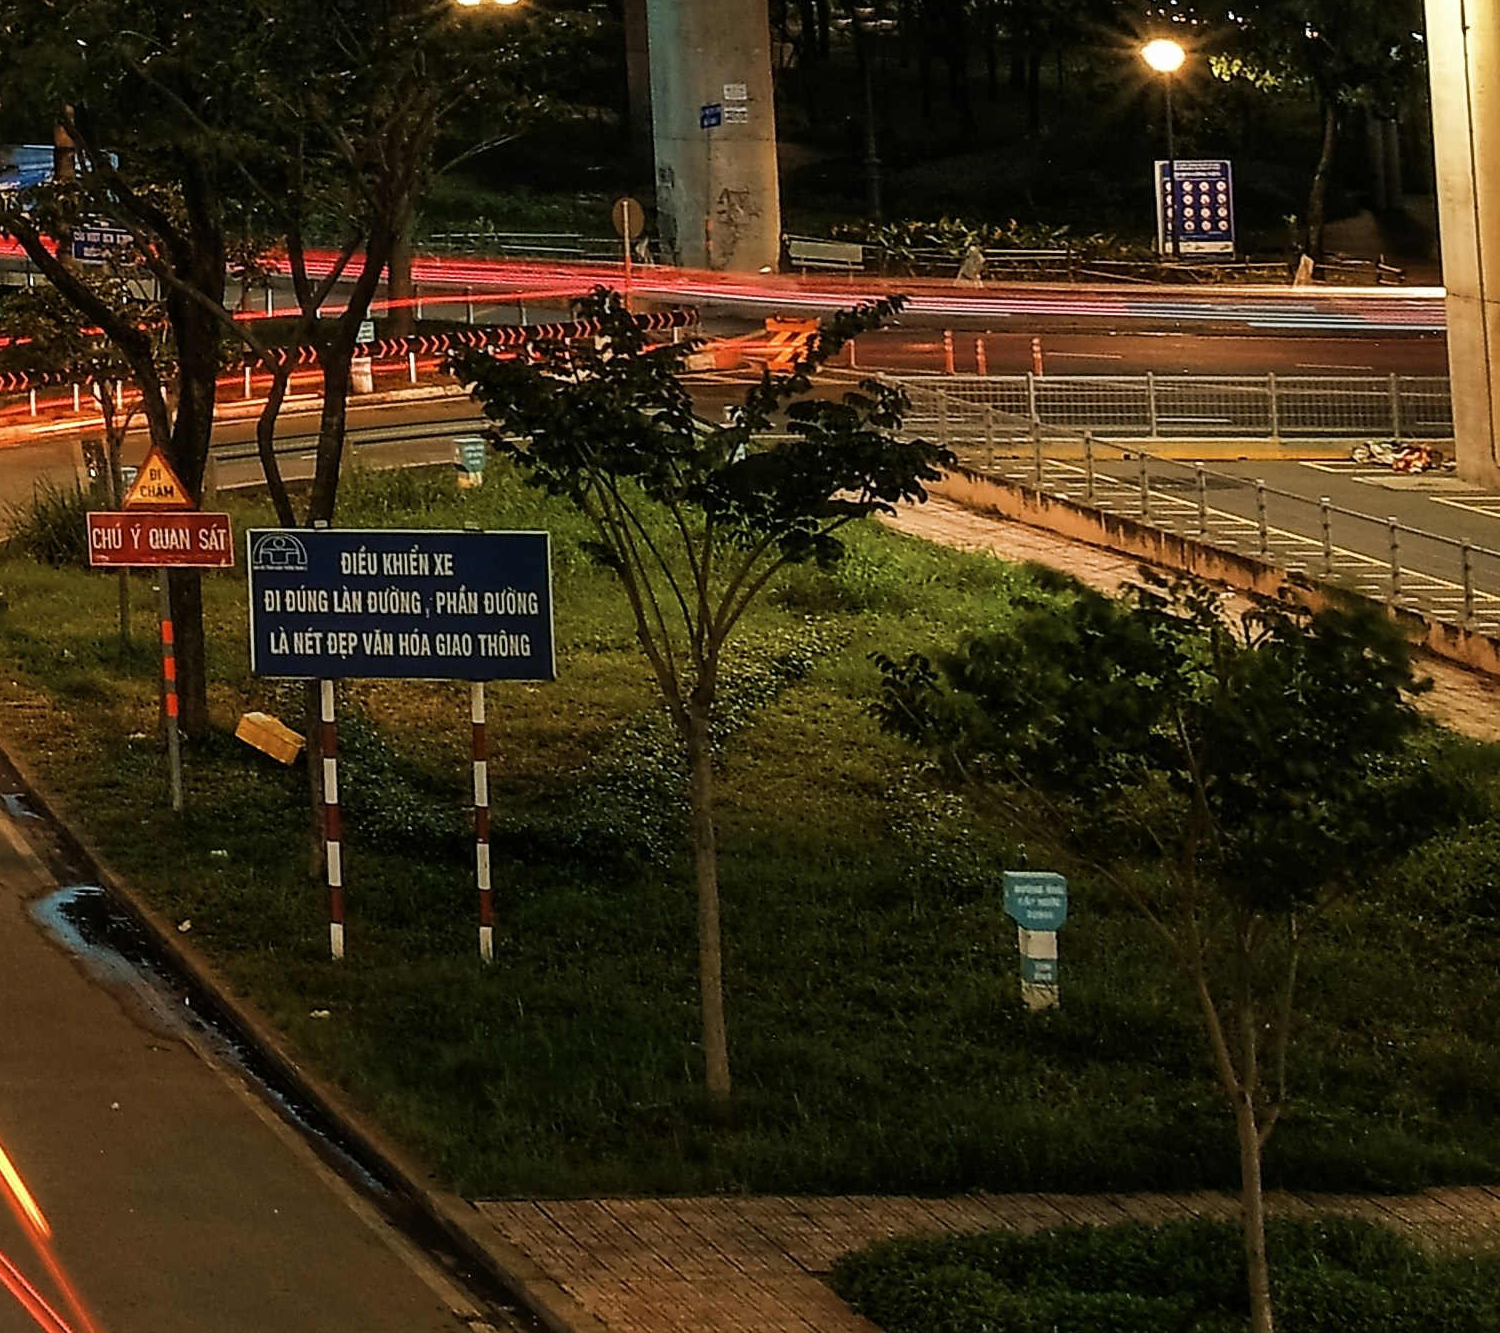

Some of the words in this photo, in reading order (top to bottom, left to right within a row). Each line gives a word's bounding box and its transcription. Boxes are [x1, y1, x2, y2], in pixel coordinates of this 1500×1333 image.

[149, 468, 162, 481] ĐI
[92, 523, 123, 550] CHÚ
[130, 523, 142, 550] Ý
[149, 527, 191, 551] QUAN
[198, 524, 227, 551] SÁT
[340, 544, 378, 575] ĐIỀU
[382, 544, 430, 576] KHIỂN
[433, 553, 455, 576] XE
[263, 589, 281, 613] ĐI
[285, 584, 329, 613] ĐÚNG
[333, 585, 363, 614] LÀN
[367, 585, 422, 615] ĐƯỜNG
[483, 586, 539, 616] ĐƯỜNG
[270, 626, 290, 655] LÀ
[293, 627, 324, 656] NÉT
[326, 631, 359, 661] ĐẸP
[362, 629, 394, 656] VĂN
[398, 628, 432, 657] HÓA
[435, 633, 473, 657] GIAO
[477, 629, 532, 658] THÔNG
